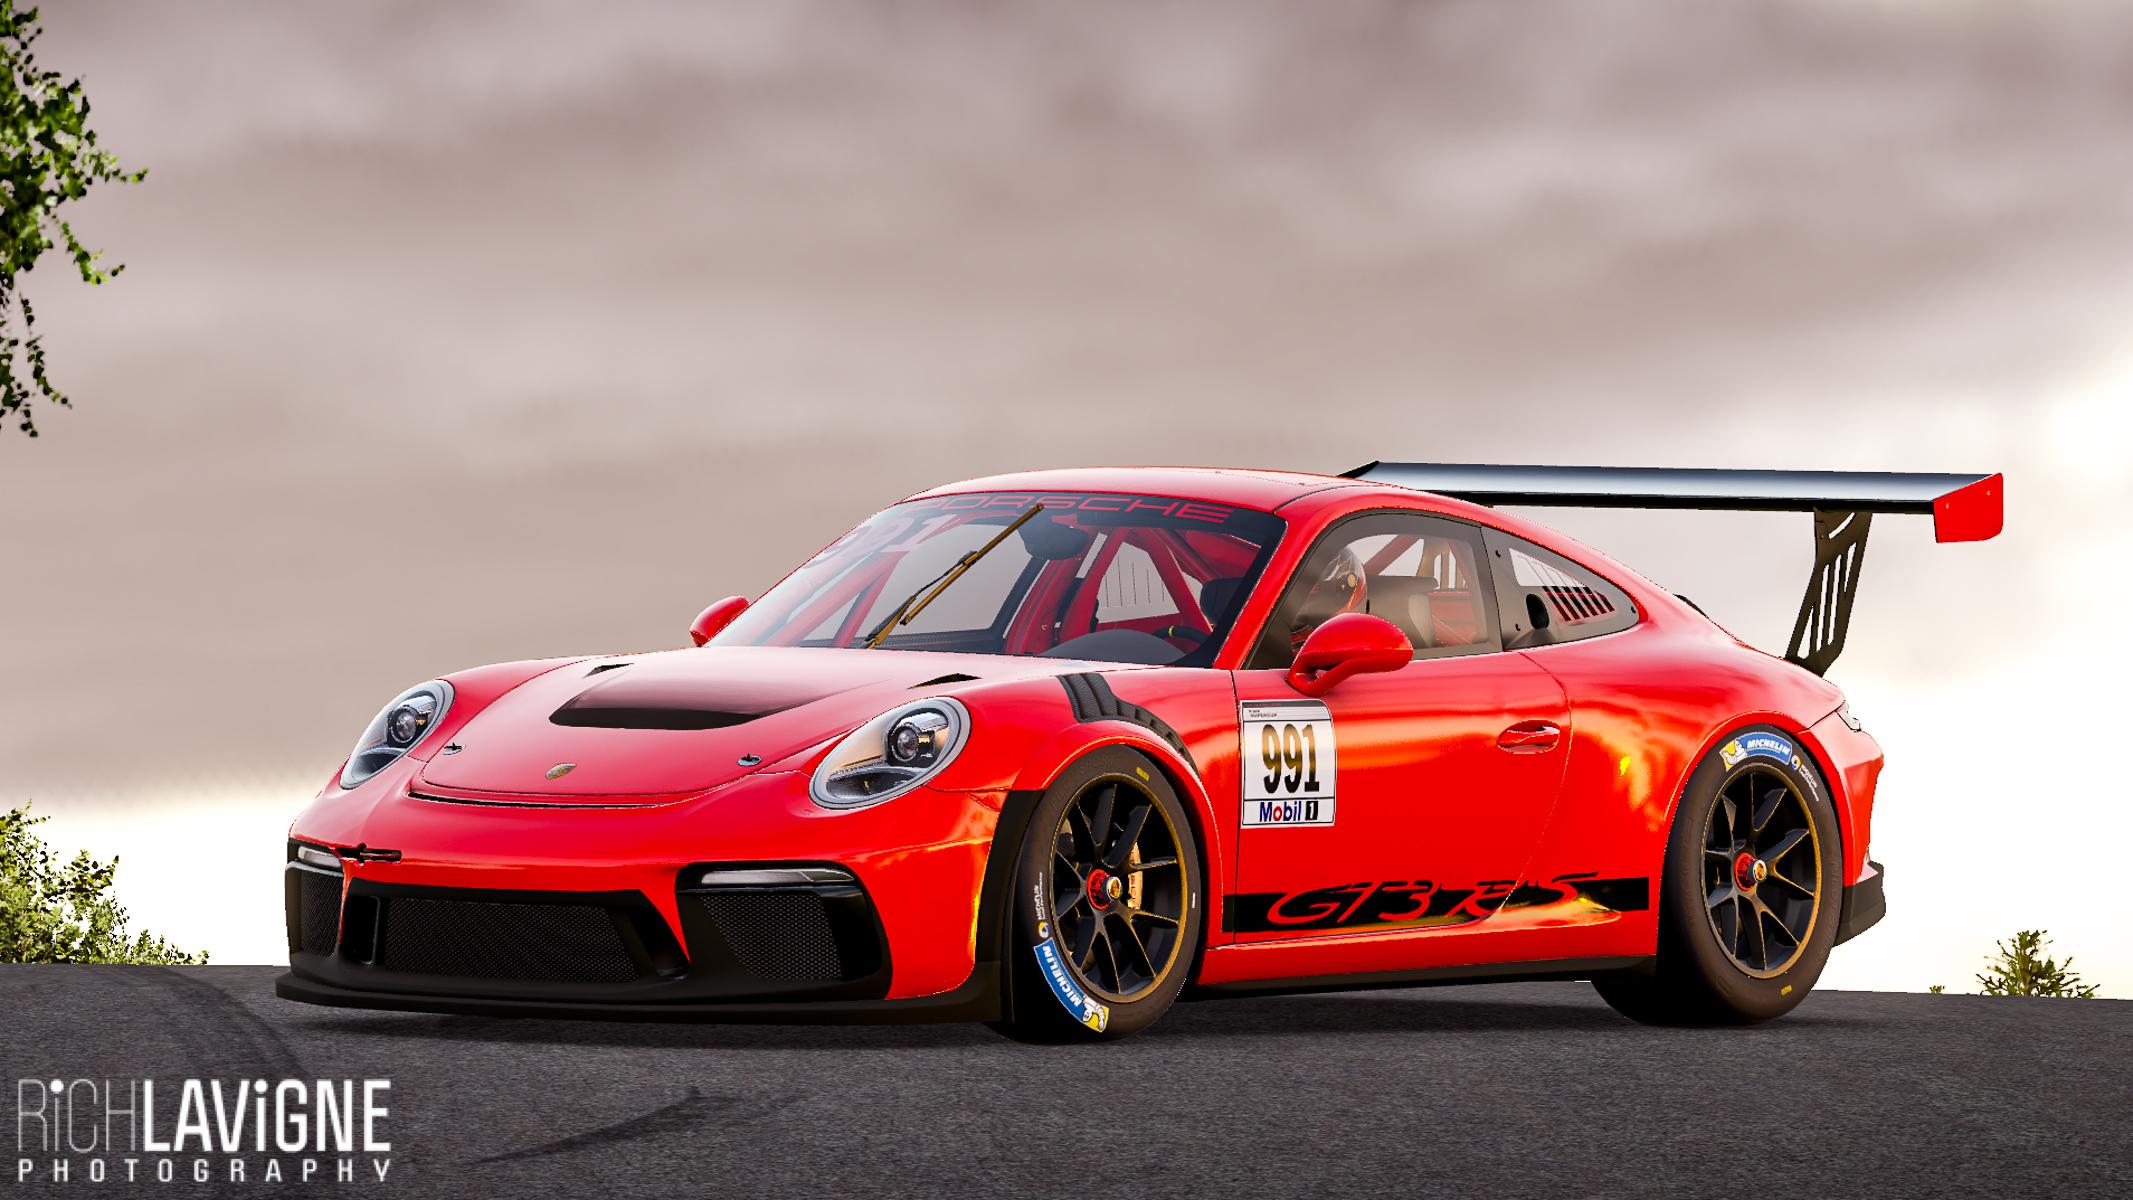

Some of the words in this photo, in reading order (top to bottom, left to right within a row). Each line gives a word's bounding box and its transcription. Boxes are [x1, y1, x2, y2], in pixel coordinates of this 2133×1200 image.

[905, 495, 1234, 523] PORSCHE
[1261, 723, 1320, 794] 991
[1746, 738, 1791, 755] MICHELIN
[1259, 800, 1302, 822] Mobil
[1307, 801, 1318, 820] 1
[1267, 879, 1441, 924] GT3
[1447, 872, 1599, 916] RS
[1042, 945, 1082, 1007] MICHELIN
